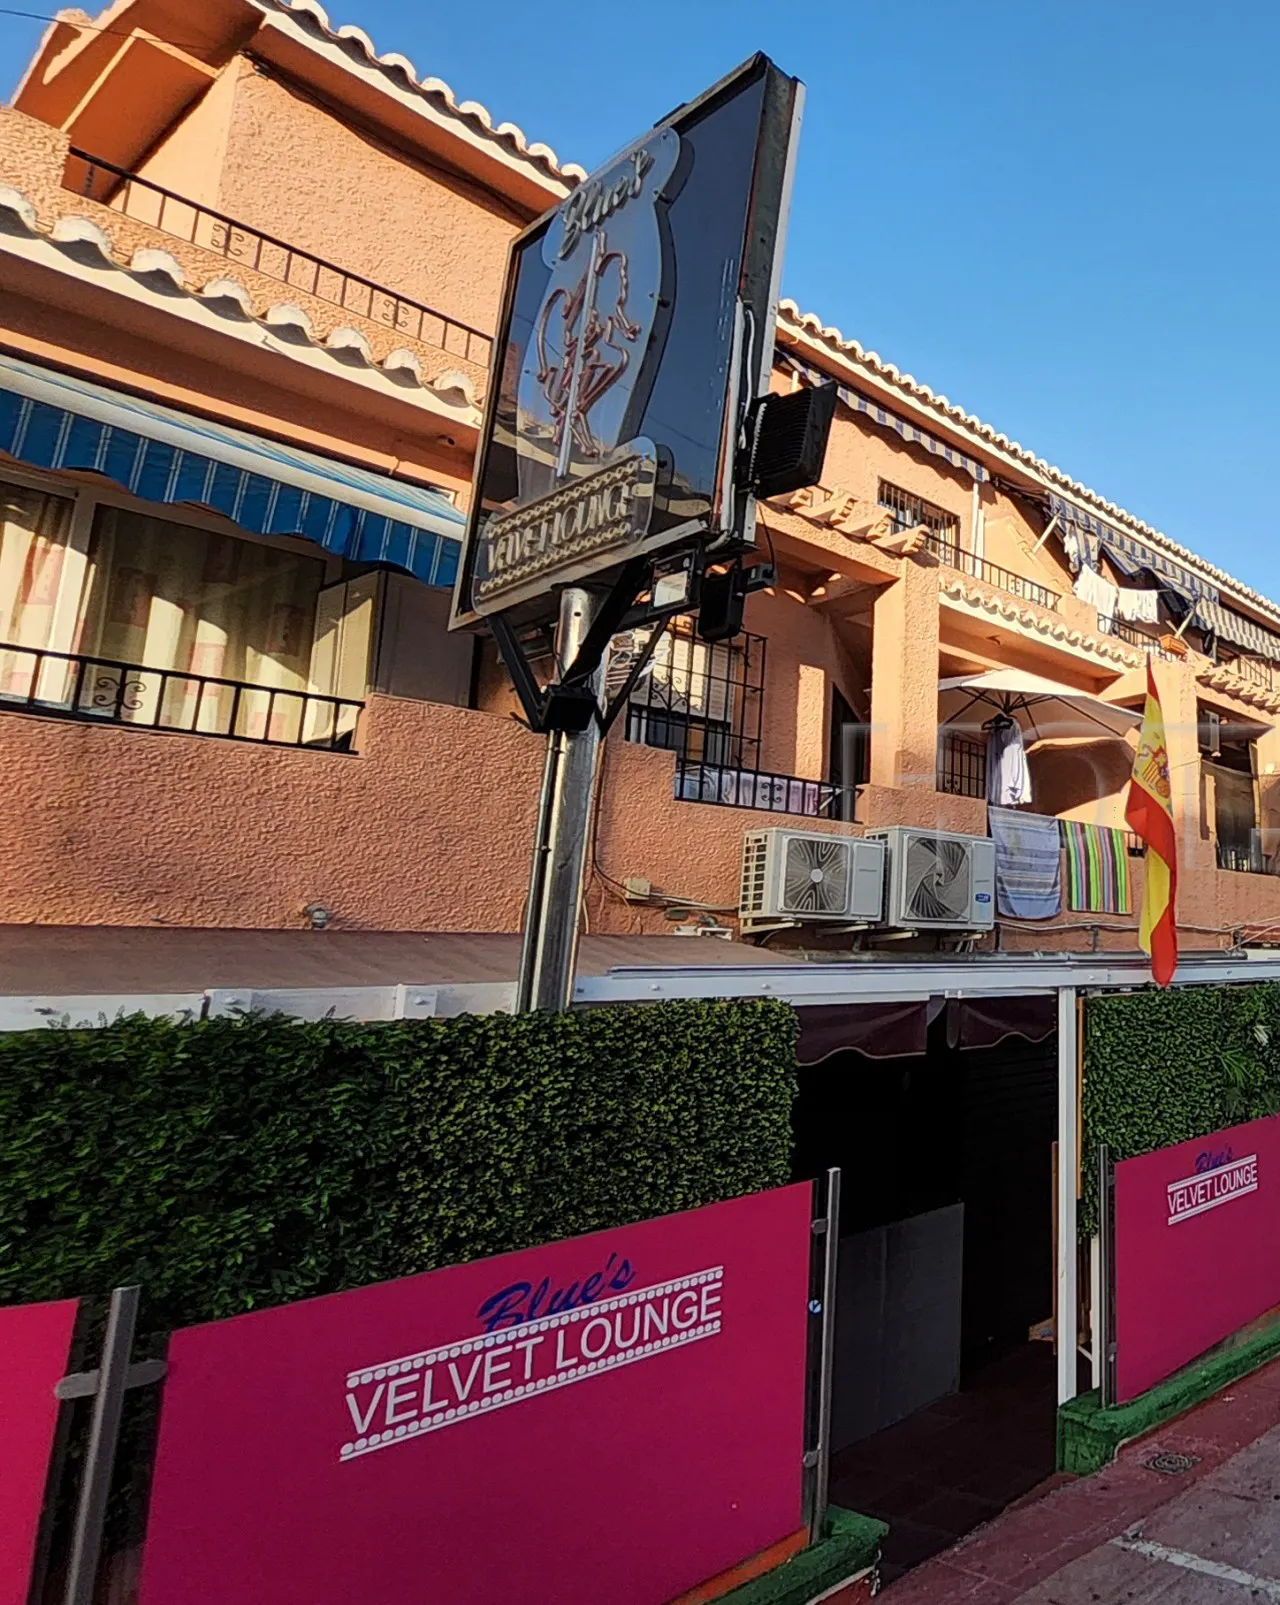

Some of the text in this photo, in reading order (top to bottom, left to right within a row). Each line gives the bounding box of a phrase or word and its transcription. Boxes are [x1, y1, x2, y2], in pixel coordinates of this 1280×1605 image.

[487, 477, 637, 574] VELVET LOUNGE
[1167, 1162, 1258, 1215] VELVET LOUNGE
[476, 1251, 636, 1334] Blue's
[345, 1281, 722, 1435] VELVET LOUNGE
